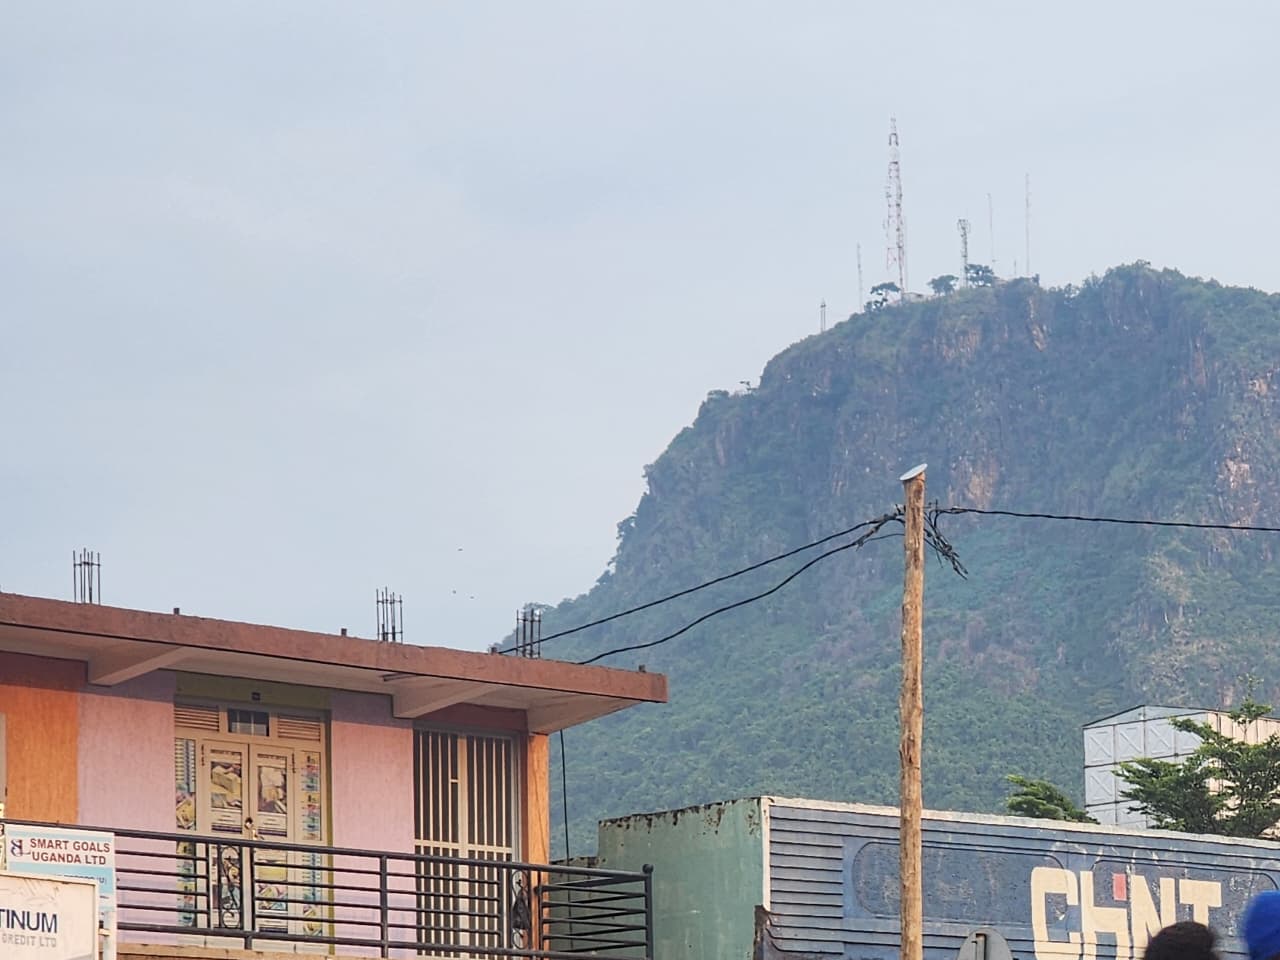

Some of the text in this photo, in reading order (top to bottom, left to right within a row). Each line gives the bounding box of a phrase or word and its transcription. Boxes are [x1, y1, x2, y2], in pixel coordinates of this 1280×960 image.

[30, 838, 69, 850] SMART
[73, 841, 110, 853] GOALS
[32, 851, 107, 865] UGANDA LTD
[1, 933, 57, 947] CREDIT LTD
